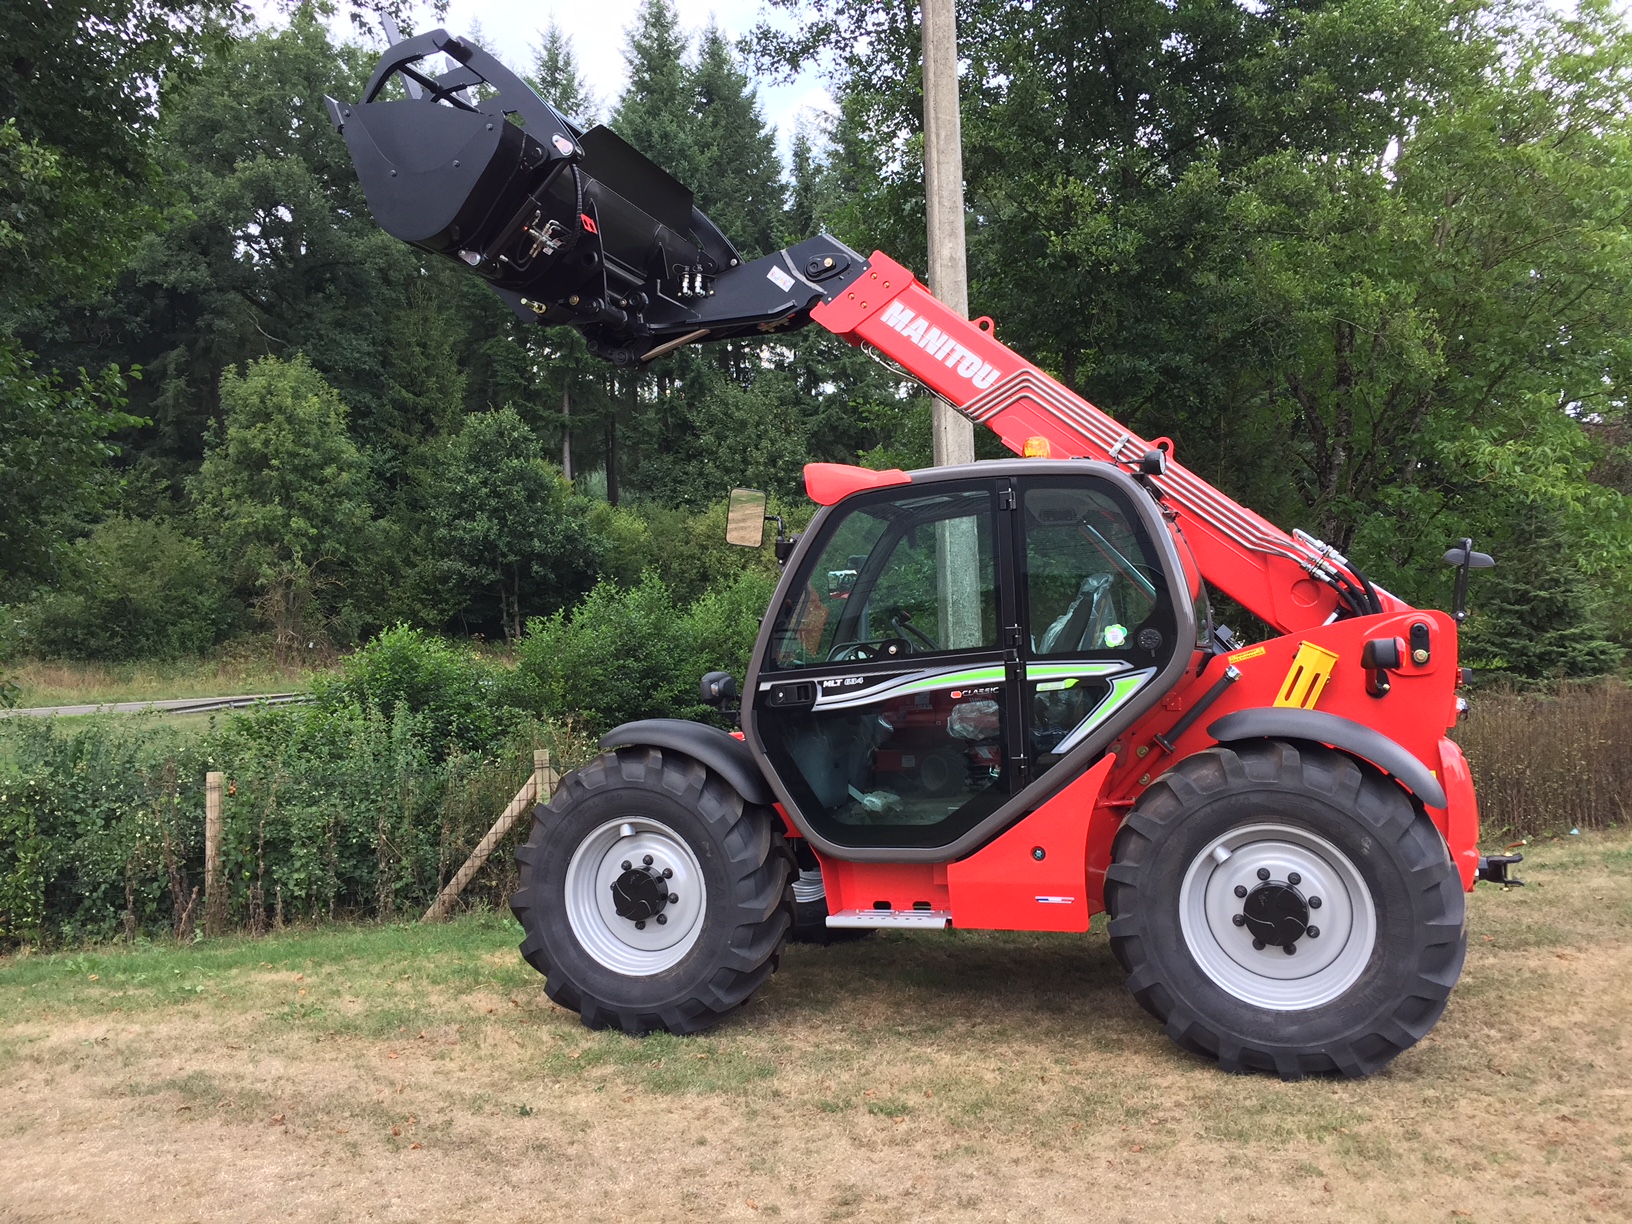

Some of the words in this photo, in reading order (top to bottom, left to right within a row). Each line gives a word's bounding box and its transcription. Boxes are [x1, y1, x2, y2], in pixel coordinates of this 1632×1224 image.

[880, 299, 1001, 389] MANITOU
[823, 679, 843, 688] MLT
[962, 686, 1000, 697] CLASSIC
